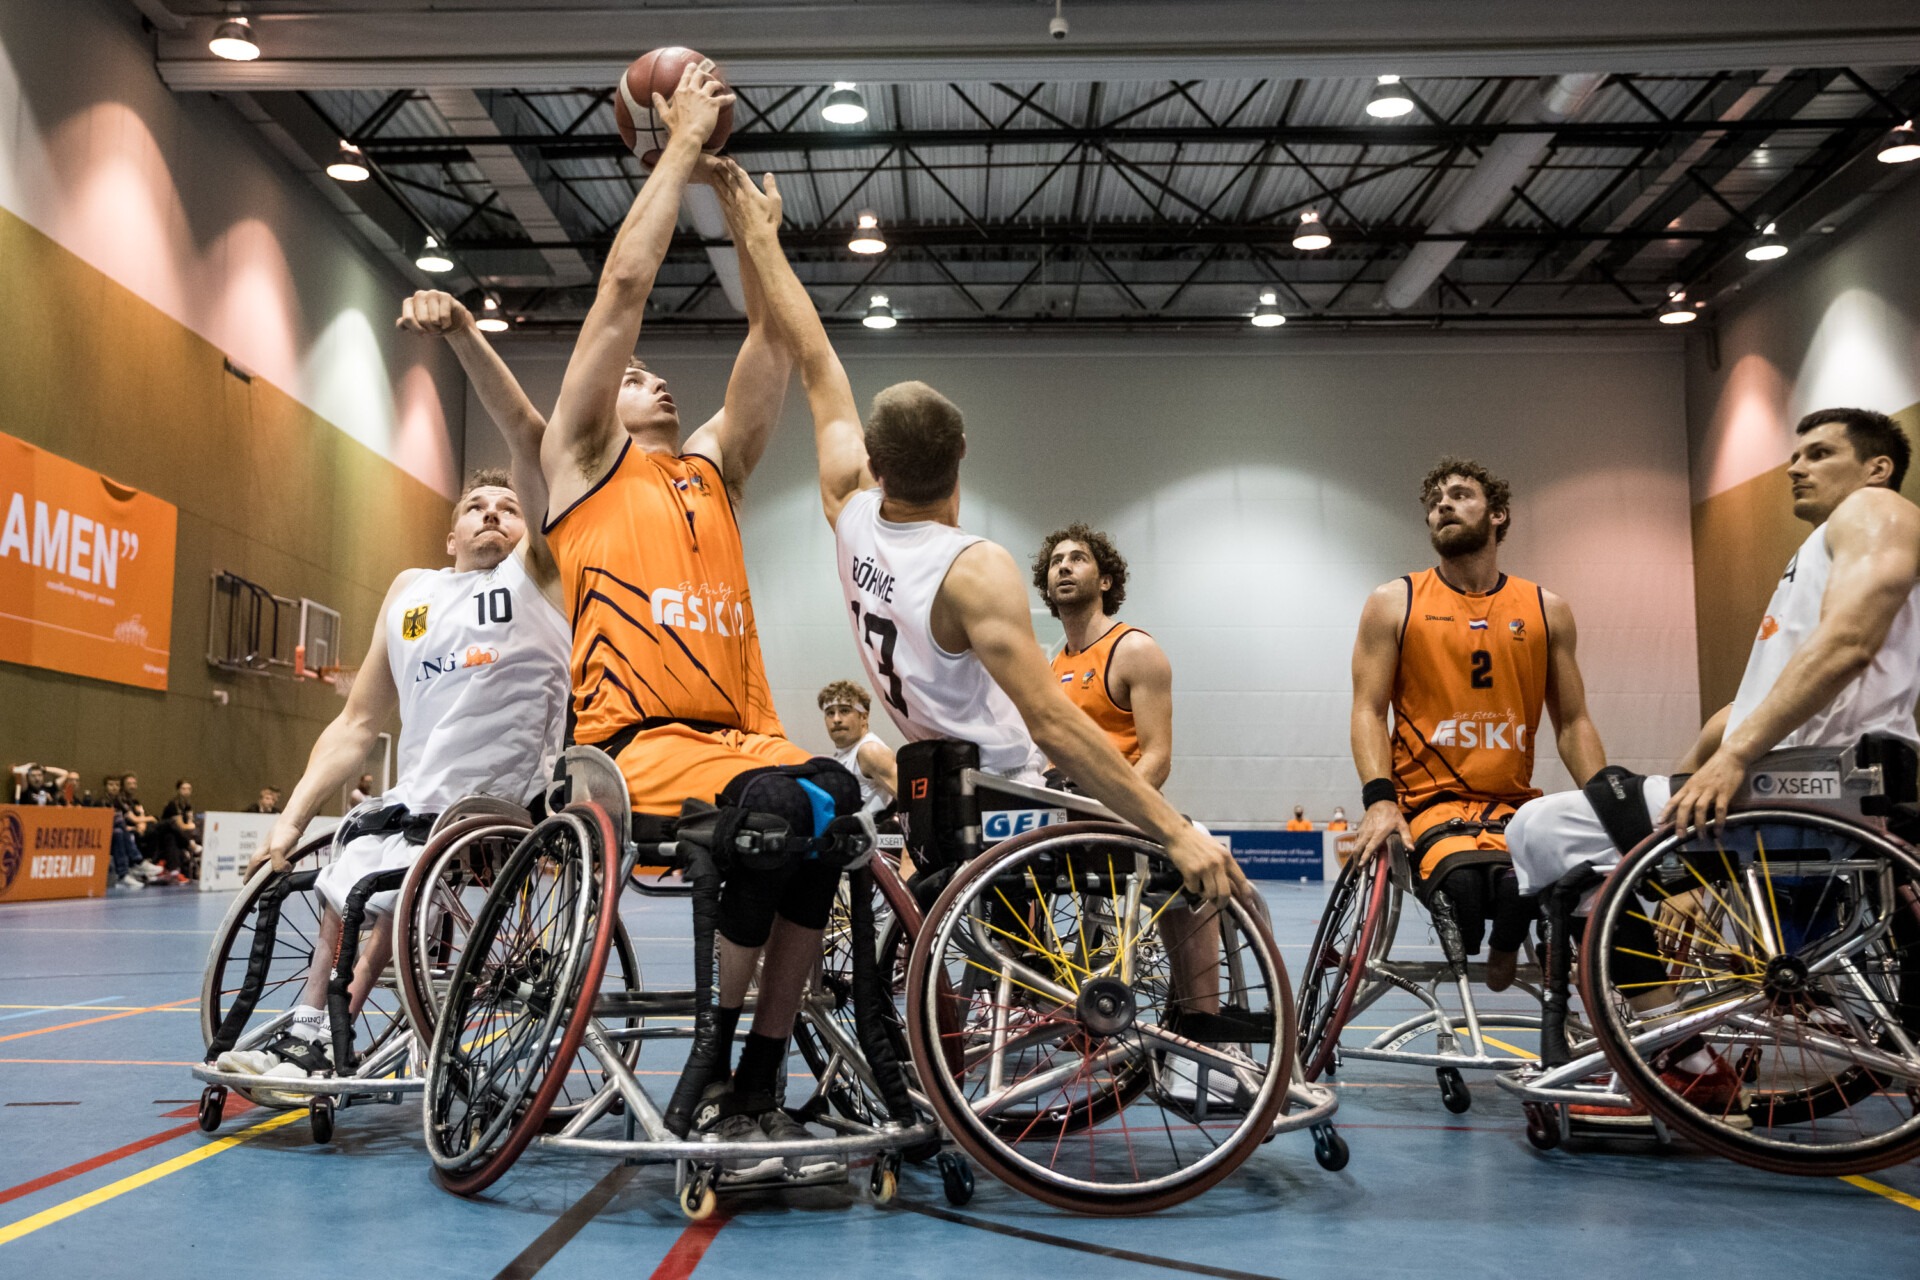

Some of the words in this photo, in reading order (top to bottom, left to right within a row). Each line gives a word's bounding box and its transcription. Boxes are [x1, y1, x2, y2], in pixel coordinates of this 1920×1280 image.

[853, 555, 896, 604] BÖHME
[473, 587, 513, 626] 10
[1471, 649, 1493, 690] 2
[1777, 777, 1833, 795] XSEAT
[35, 827, 102, 849] BASKETBALL
[880, 837, 903, 846] XSEAT
[30, 854, 96, 879] NEDERLAND
